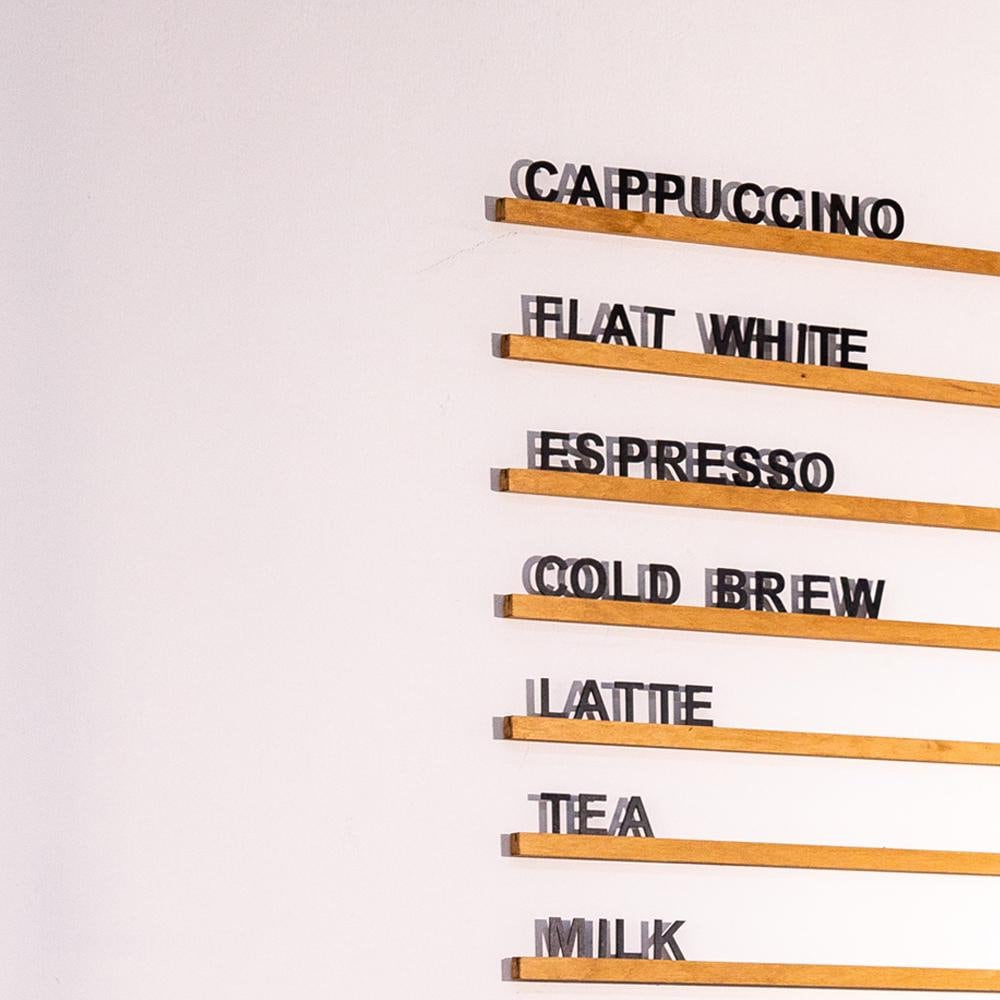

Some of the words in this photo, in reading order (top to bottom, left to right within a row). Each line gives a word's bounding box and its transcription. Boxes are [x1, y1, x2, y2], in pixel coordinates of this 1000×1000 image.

[525, 160, 905, 240] CAPPUCCINO
[535, 295, 675, 349] FLAT
[709, 313, 868, 370] WHITE
[540, 431, 835, 494] ESPRESSO
[535, 555, 682, 605] COLD
[716, 567, 886, 620] BREW
[540, 677, 714, 727] LATTE
[540, 792, 655, 838] TEA
[548, 916, 686, 961] MILK
